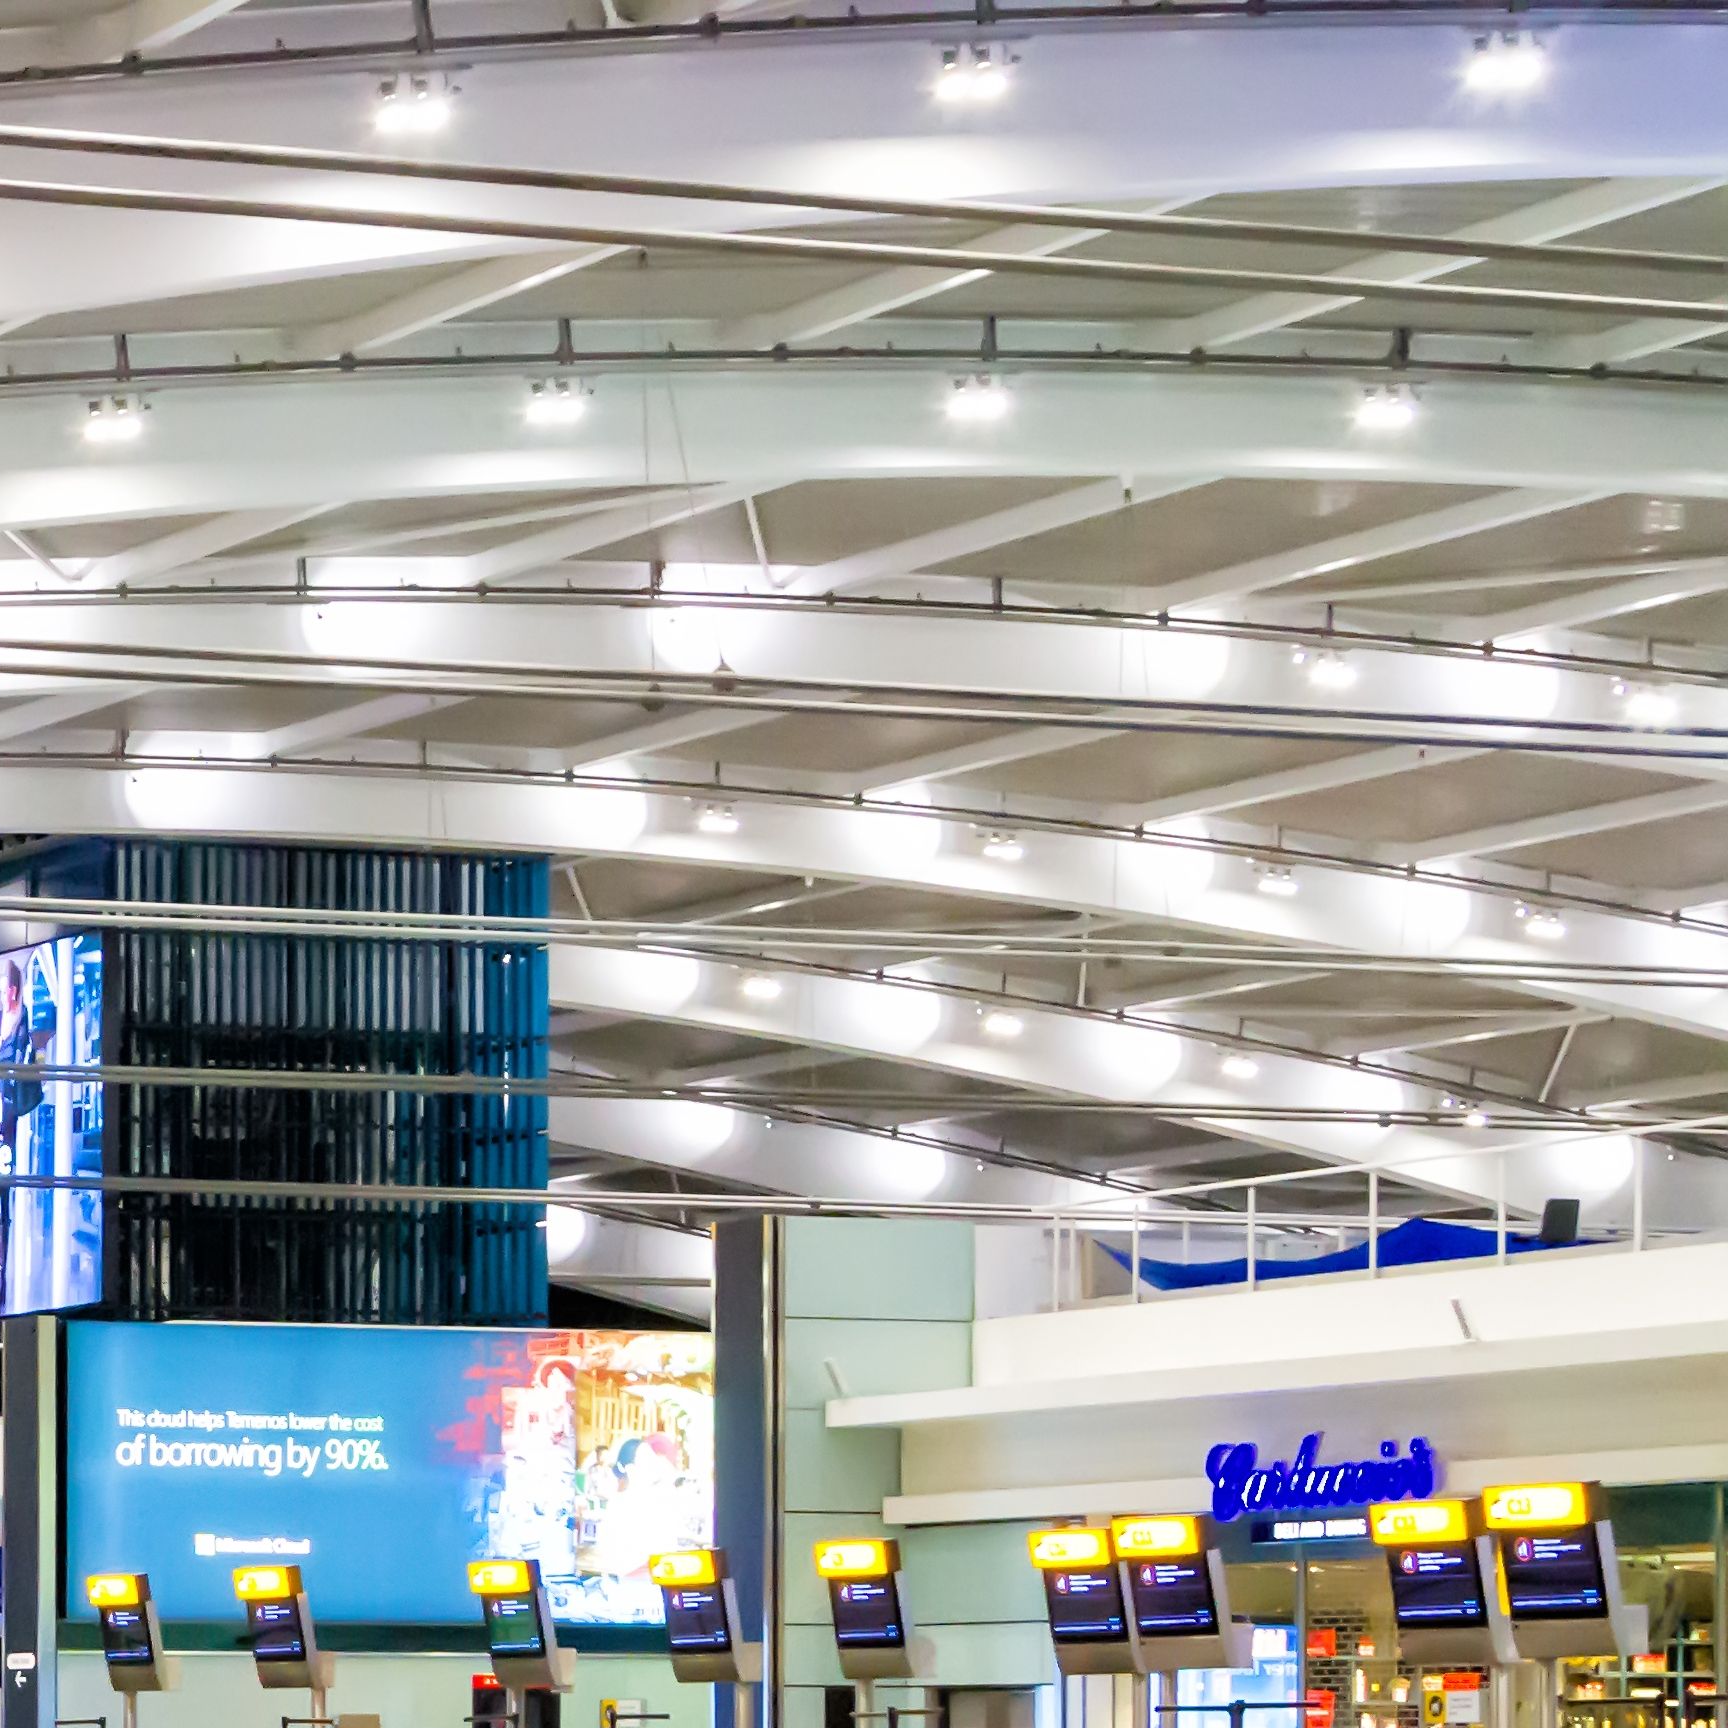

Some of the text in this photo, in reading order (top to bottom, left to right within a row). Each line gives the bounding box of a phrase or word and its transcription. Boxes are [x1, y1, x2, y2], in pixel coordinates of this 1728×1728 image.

[116, 1408, 385, 1432] This cloud helps Temenos lower the cost
[115, 1433, 390, 1477] of borrowing by 90%.
